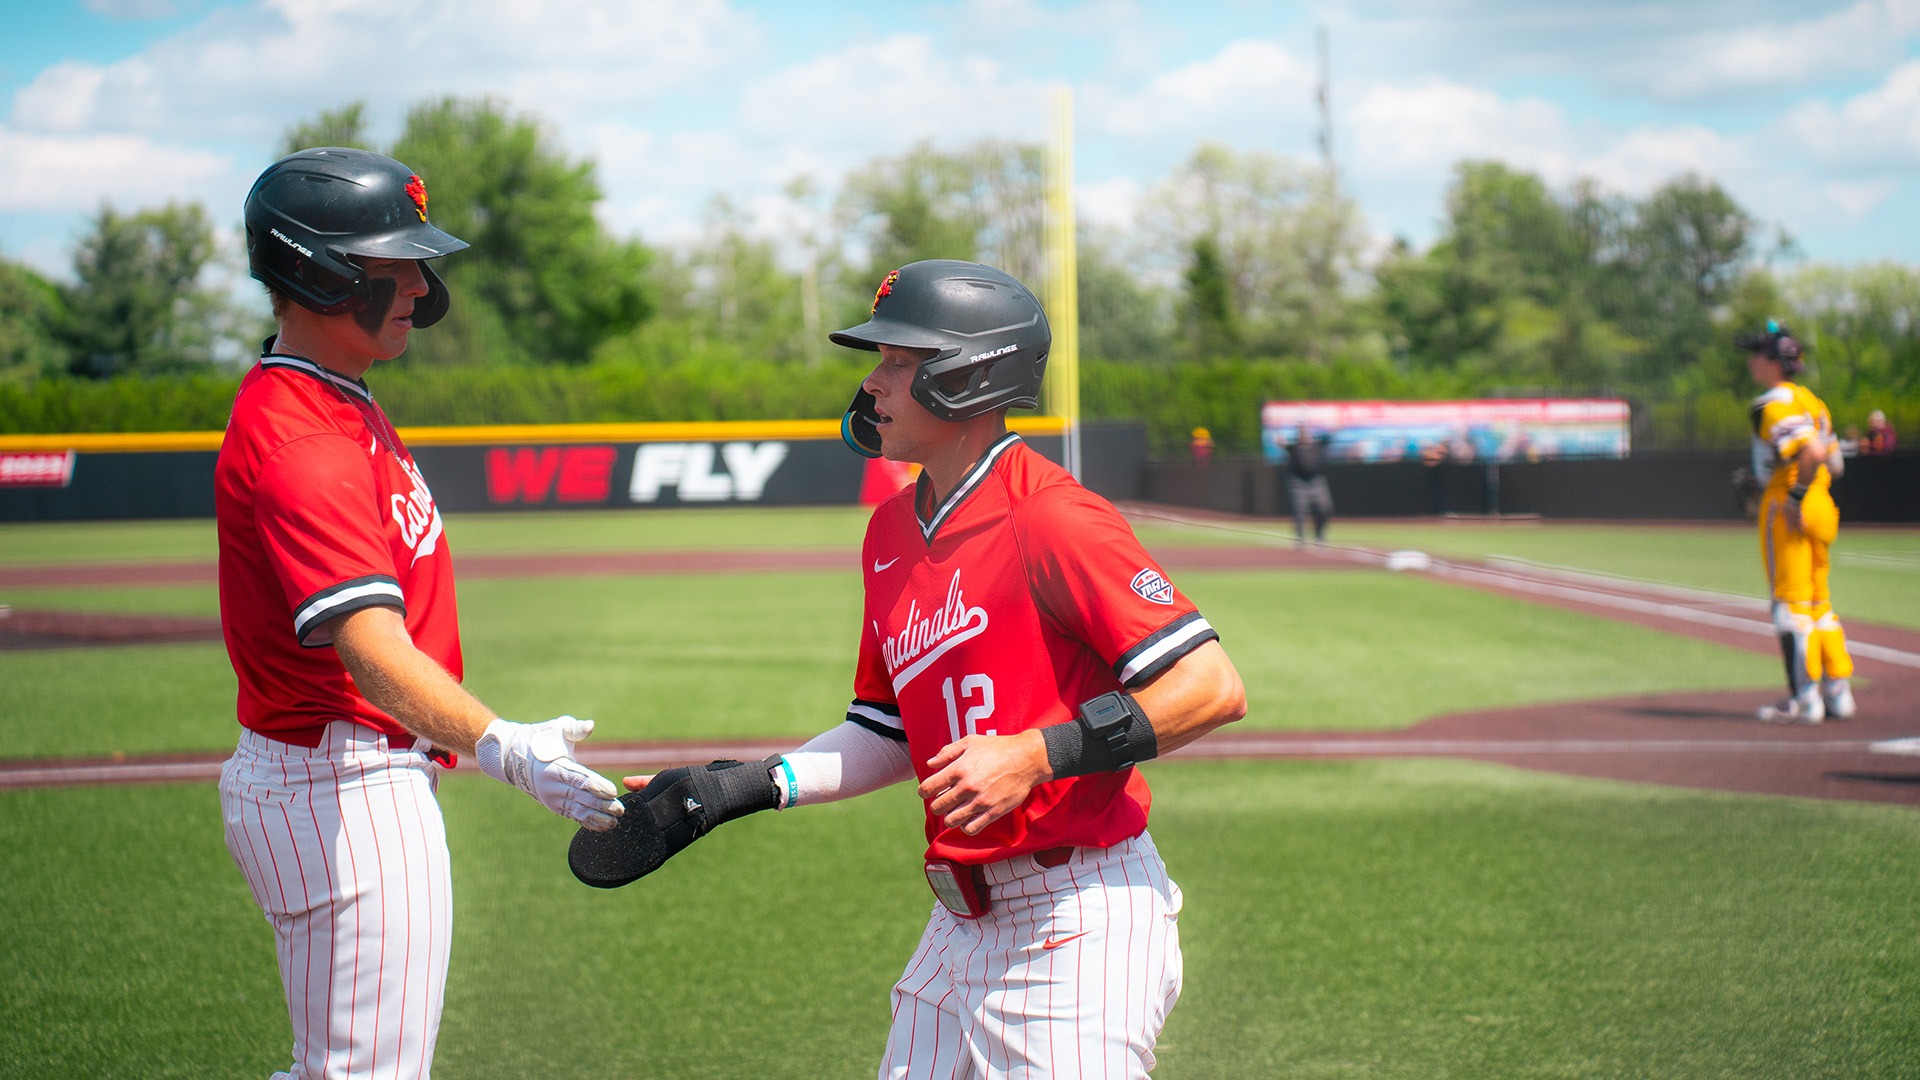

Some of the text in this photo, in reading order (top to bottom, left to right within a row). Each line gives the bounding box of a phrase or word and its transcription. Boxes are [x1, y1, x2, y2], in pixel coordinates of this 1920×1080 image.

[270, 227, 314, 258] RAWLINGS
[969, 343, 1019, 363] RAWLINGS
[486, 442, 788, 502] WE FLY
[942, 673, 995, 742] 12
